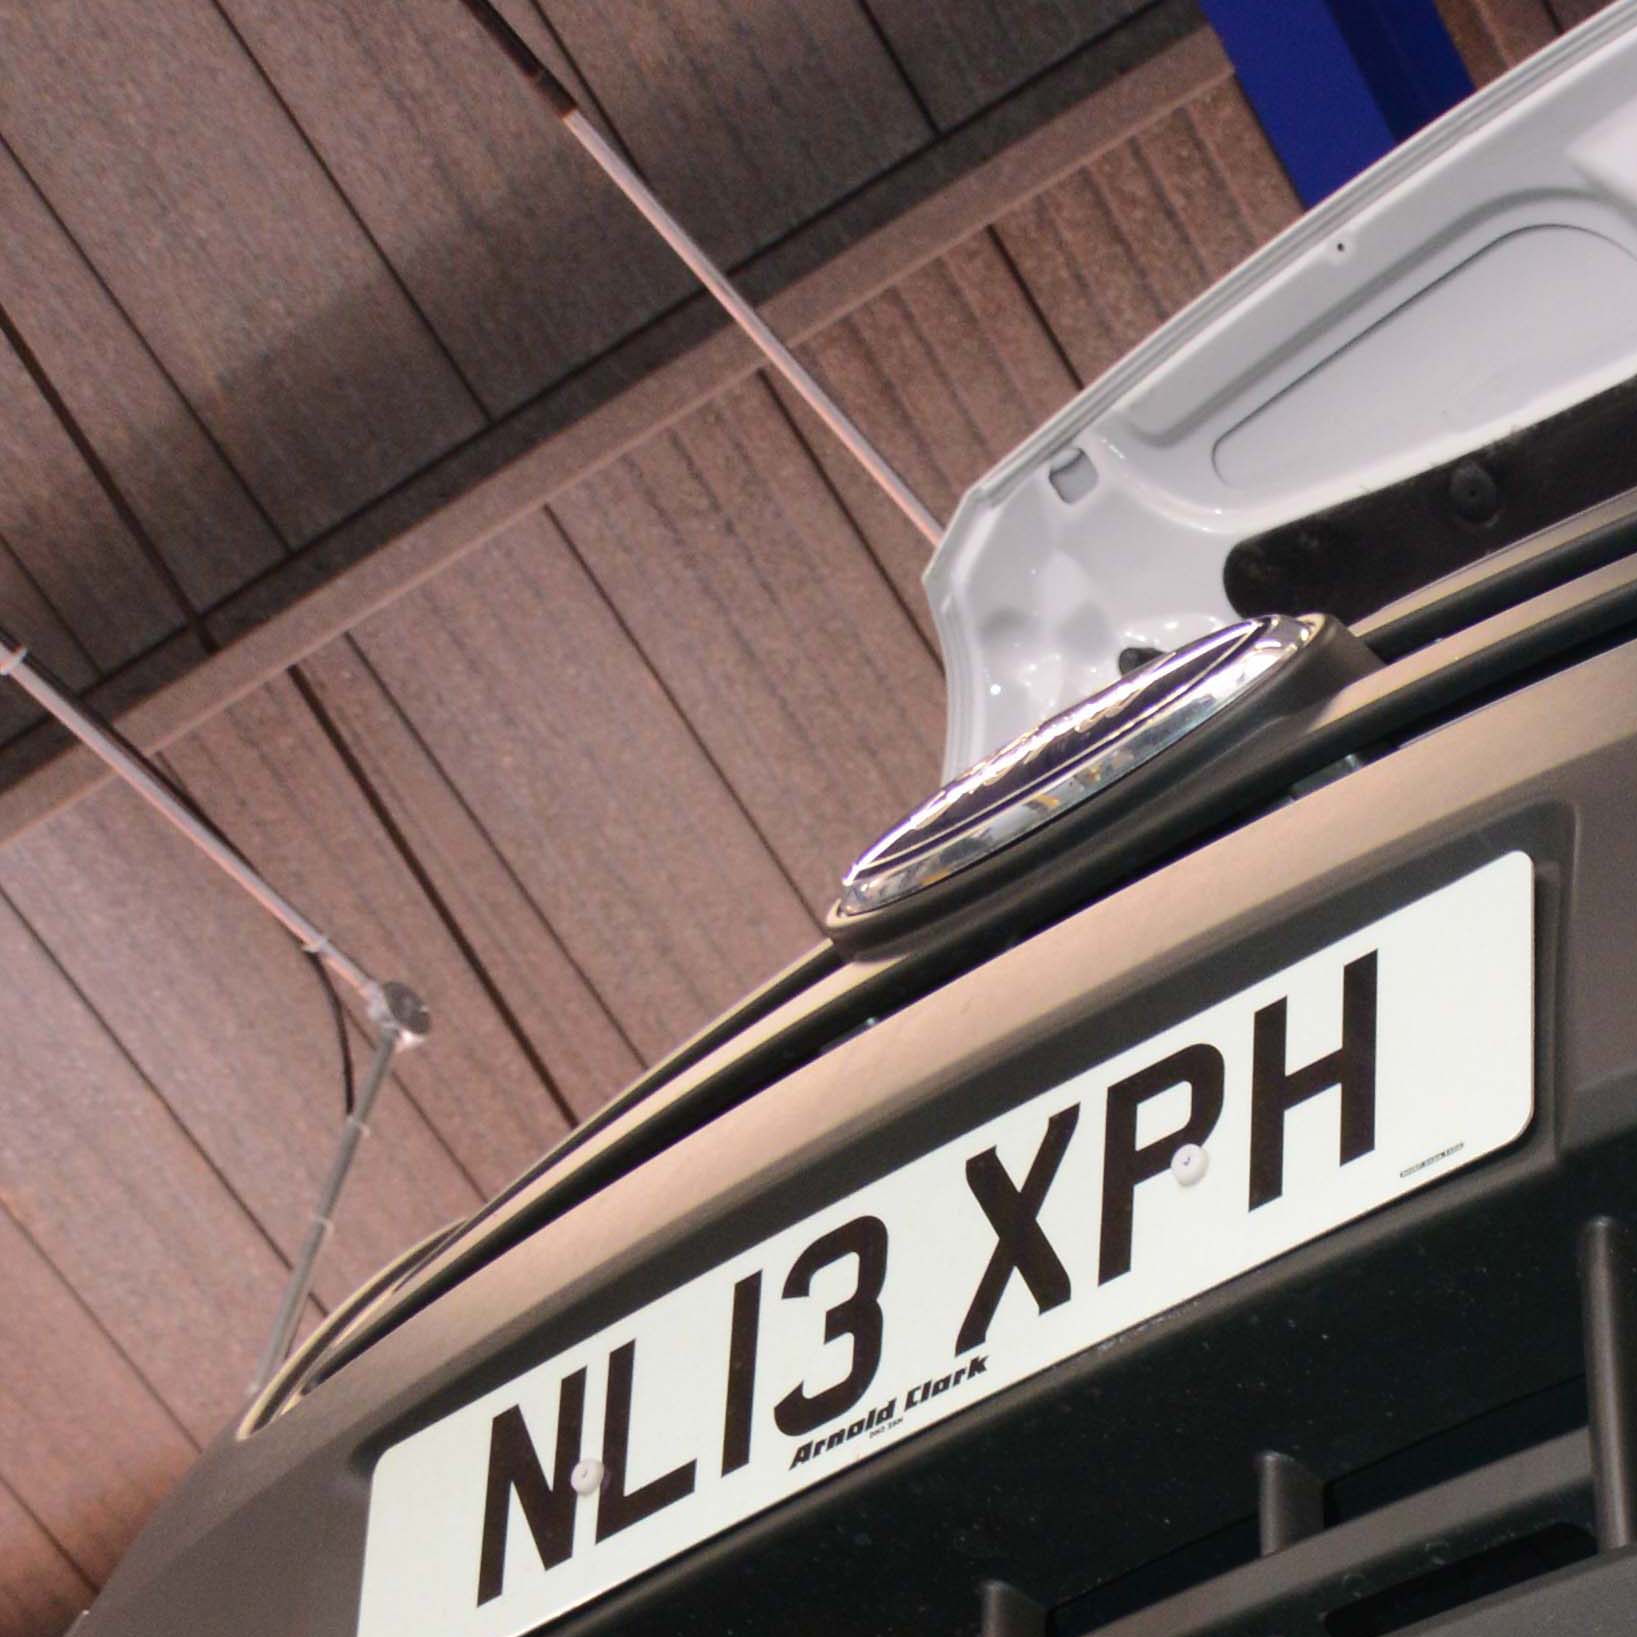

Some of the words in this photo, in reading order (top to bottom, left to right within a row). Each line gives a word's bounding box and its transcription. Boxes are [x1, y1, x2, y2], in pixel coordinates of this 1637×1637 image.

[477, 1215, 890, 1608] NL13
[954, 948, 1378, 1358] XPH
[788, 1397, 897, 1471] Arnold
[904, 1355, 990, 1413] Clark
